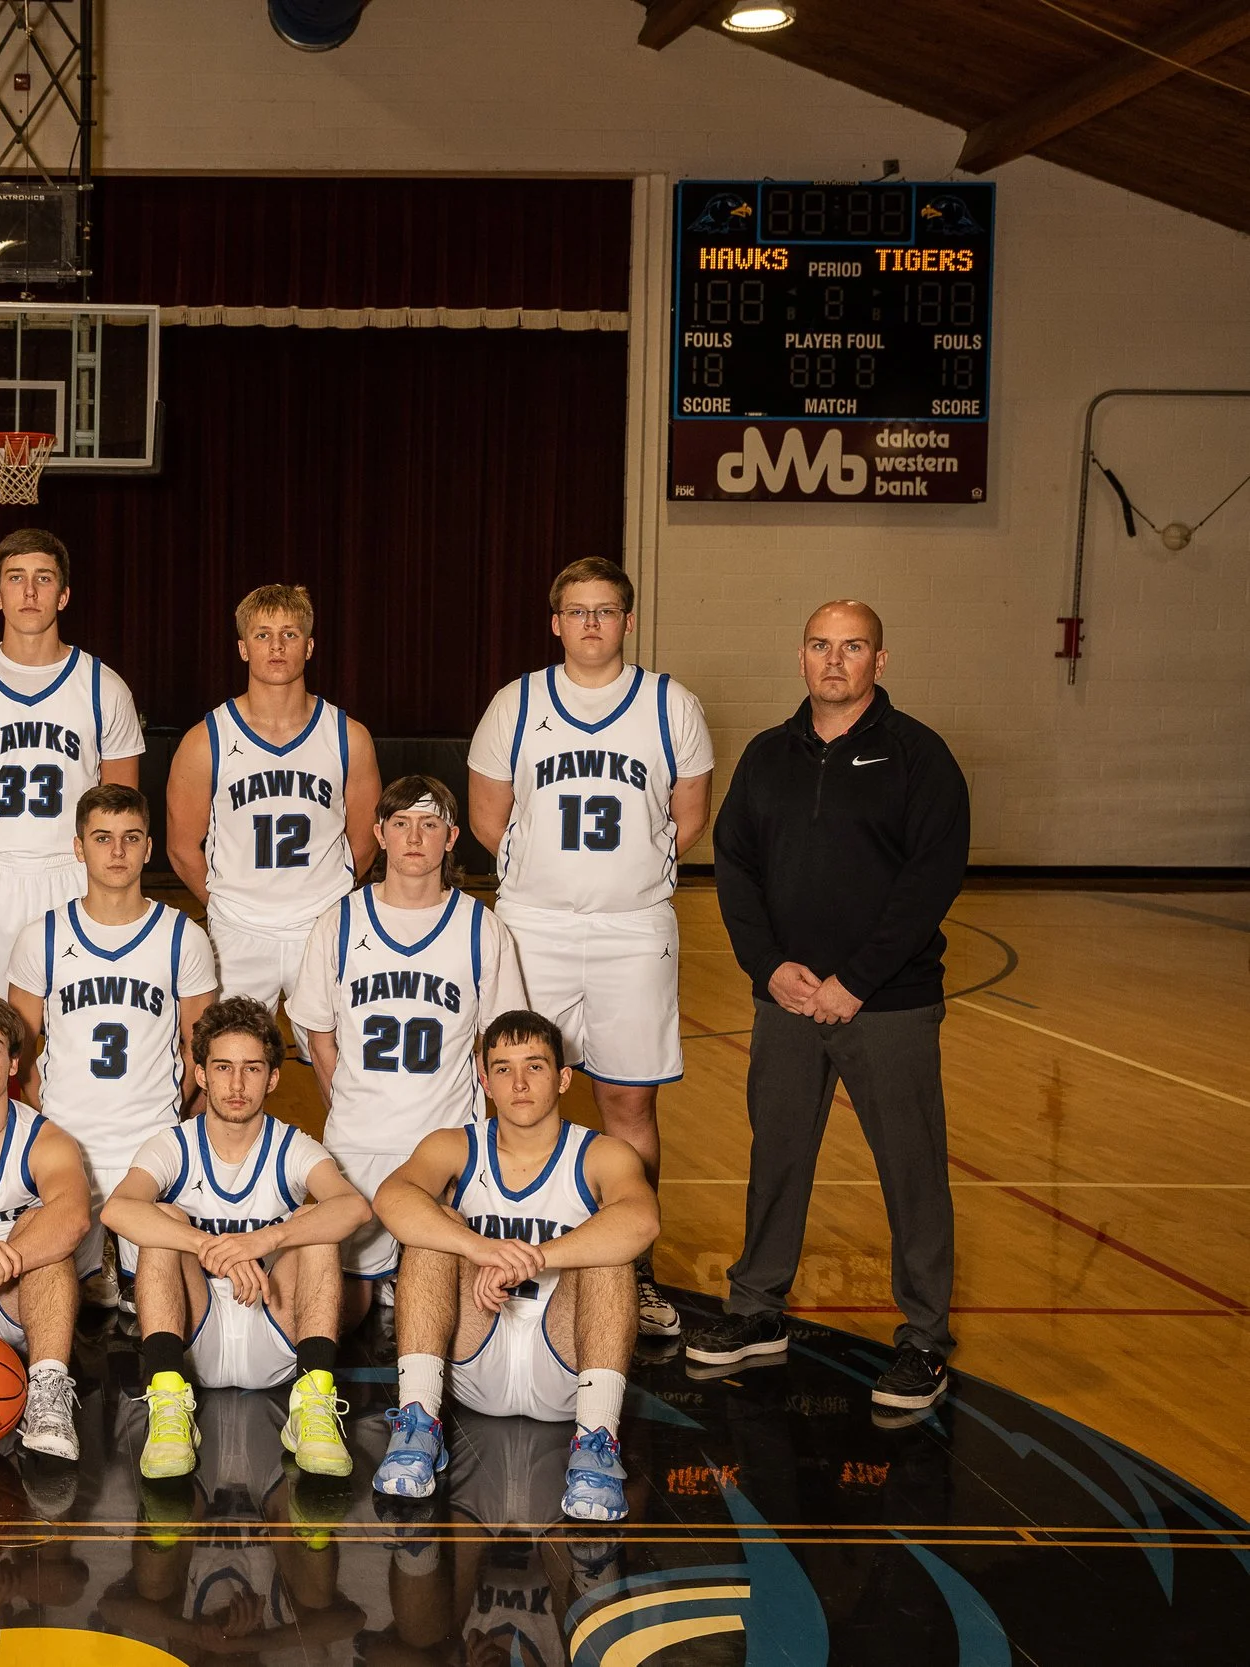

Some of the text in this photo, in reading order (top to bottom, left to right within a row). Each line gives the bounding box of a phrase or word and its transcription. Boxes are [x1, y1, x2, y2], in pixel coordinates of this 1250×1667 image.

[699, 247, 789, 270] HAWKS
[875, 248, 973, 272] TIGERS
[808, 262, 862, 277] PERIOD
[684, 333, 733, 348] FOULS
[785, 333, 884, 349] PLAYER FOUL
[933, 335, 982, 350] FOULS
[683, 398, 731, 413] SCORE
[805, 399, 857, 414] MATCH
[931, 400, 980, 415] SCORE
[875, 428, 950, 448] dakota
[875, 456, 958, 473] western
[675, 487, 695, 497] FDIC
[875, 476, 928, 496] bank
[535, 750, 647, 791] HAWKS
[228, 770, 332, 811] HAWKS
[559, 794, 622, 851] 13
[252, 814, 311, 869] 12
[59, 976, 165, 1017] HAWKS
[350, 971, 461, 1014] HAWKS
[90, 1022, 128, 1080] 3
[363, 1014, 443, 1074] 20
